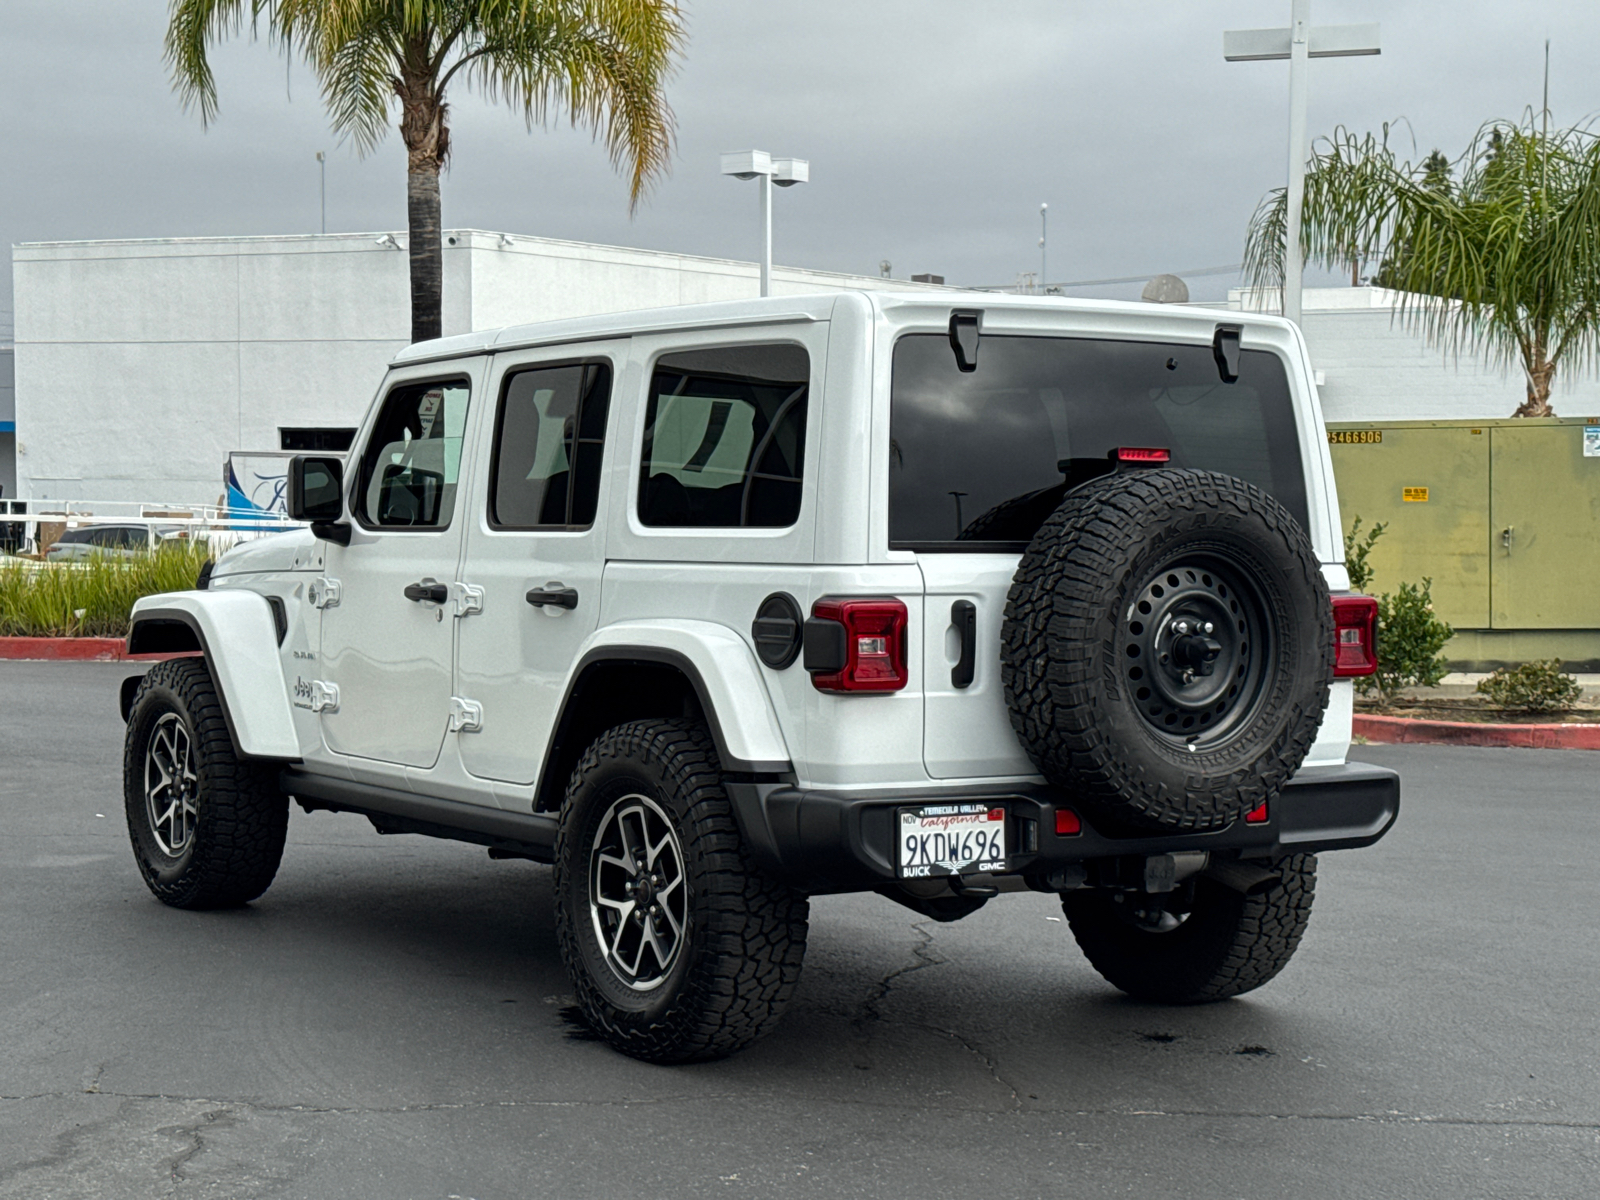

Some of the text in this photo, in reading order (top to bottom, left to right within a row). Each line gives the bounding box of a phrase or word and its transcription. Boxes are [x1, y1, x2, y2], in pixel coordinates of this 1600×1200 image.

[924, 804, 984, 816] TEMECULA VALLEY
[903, 815, 917, 825] NOV
[920, 815, 988, 831] California
[906, 828, 1001, 867] 9KDW696
[903, 861, 1006, 878] BUICK GMC
